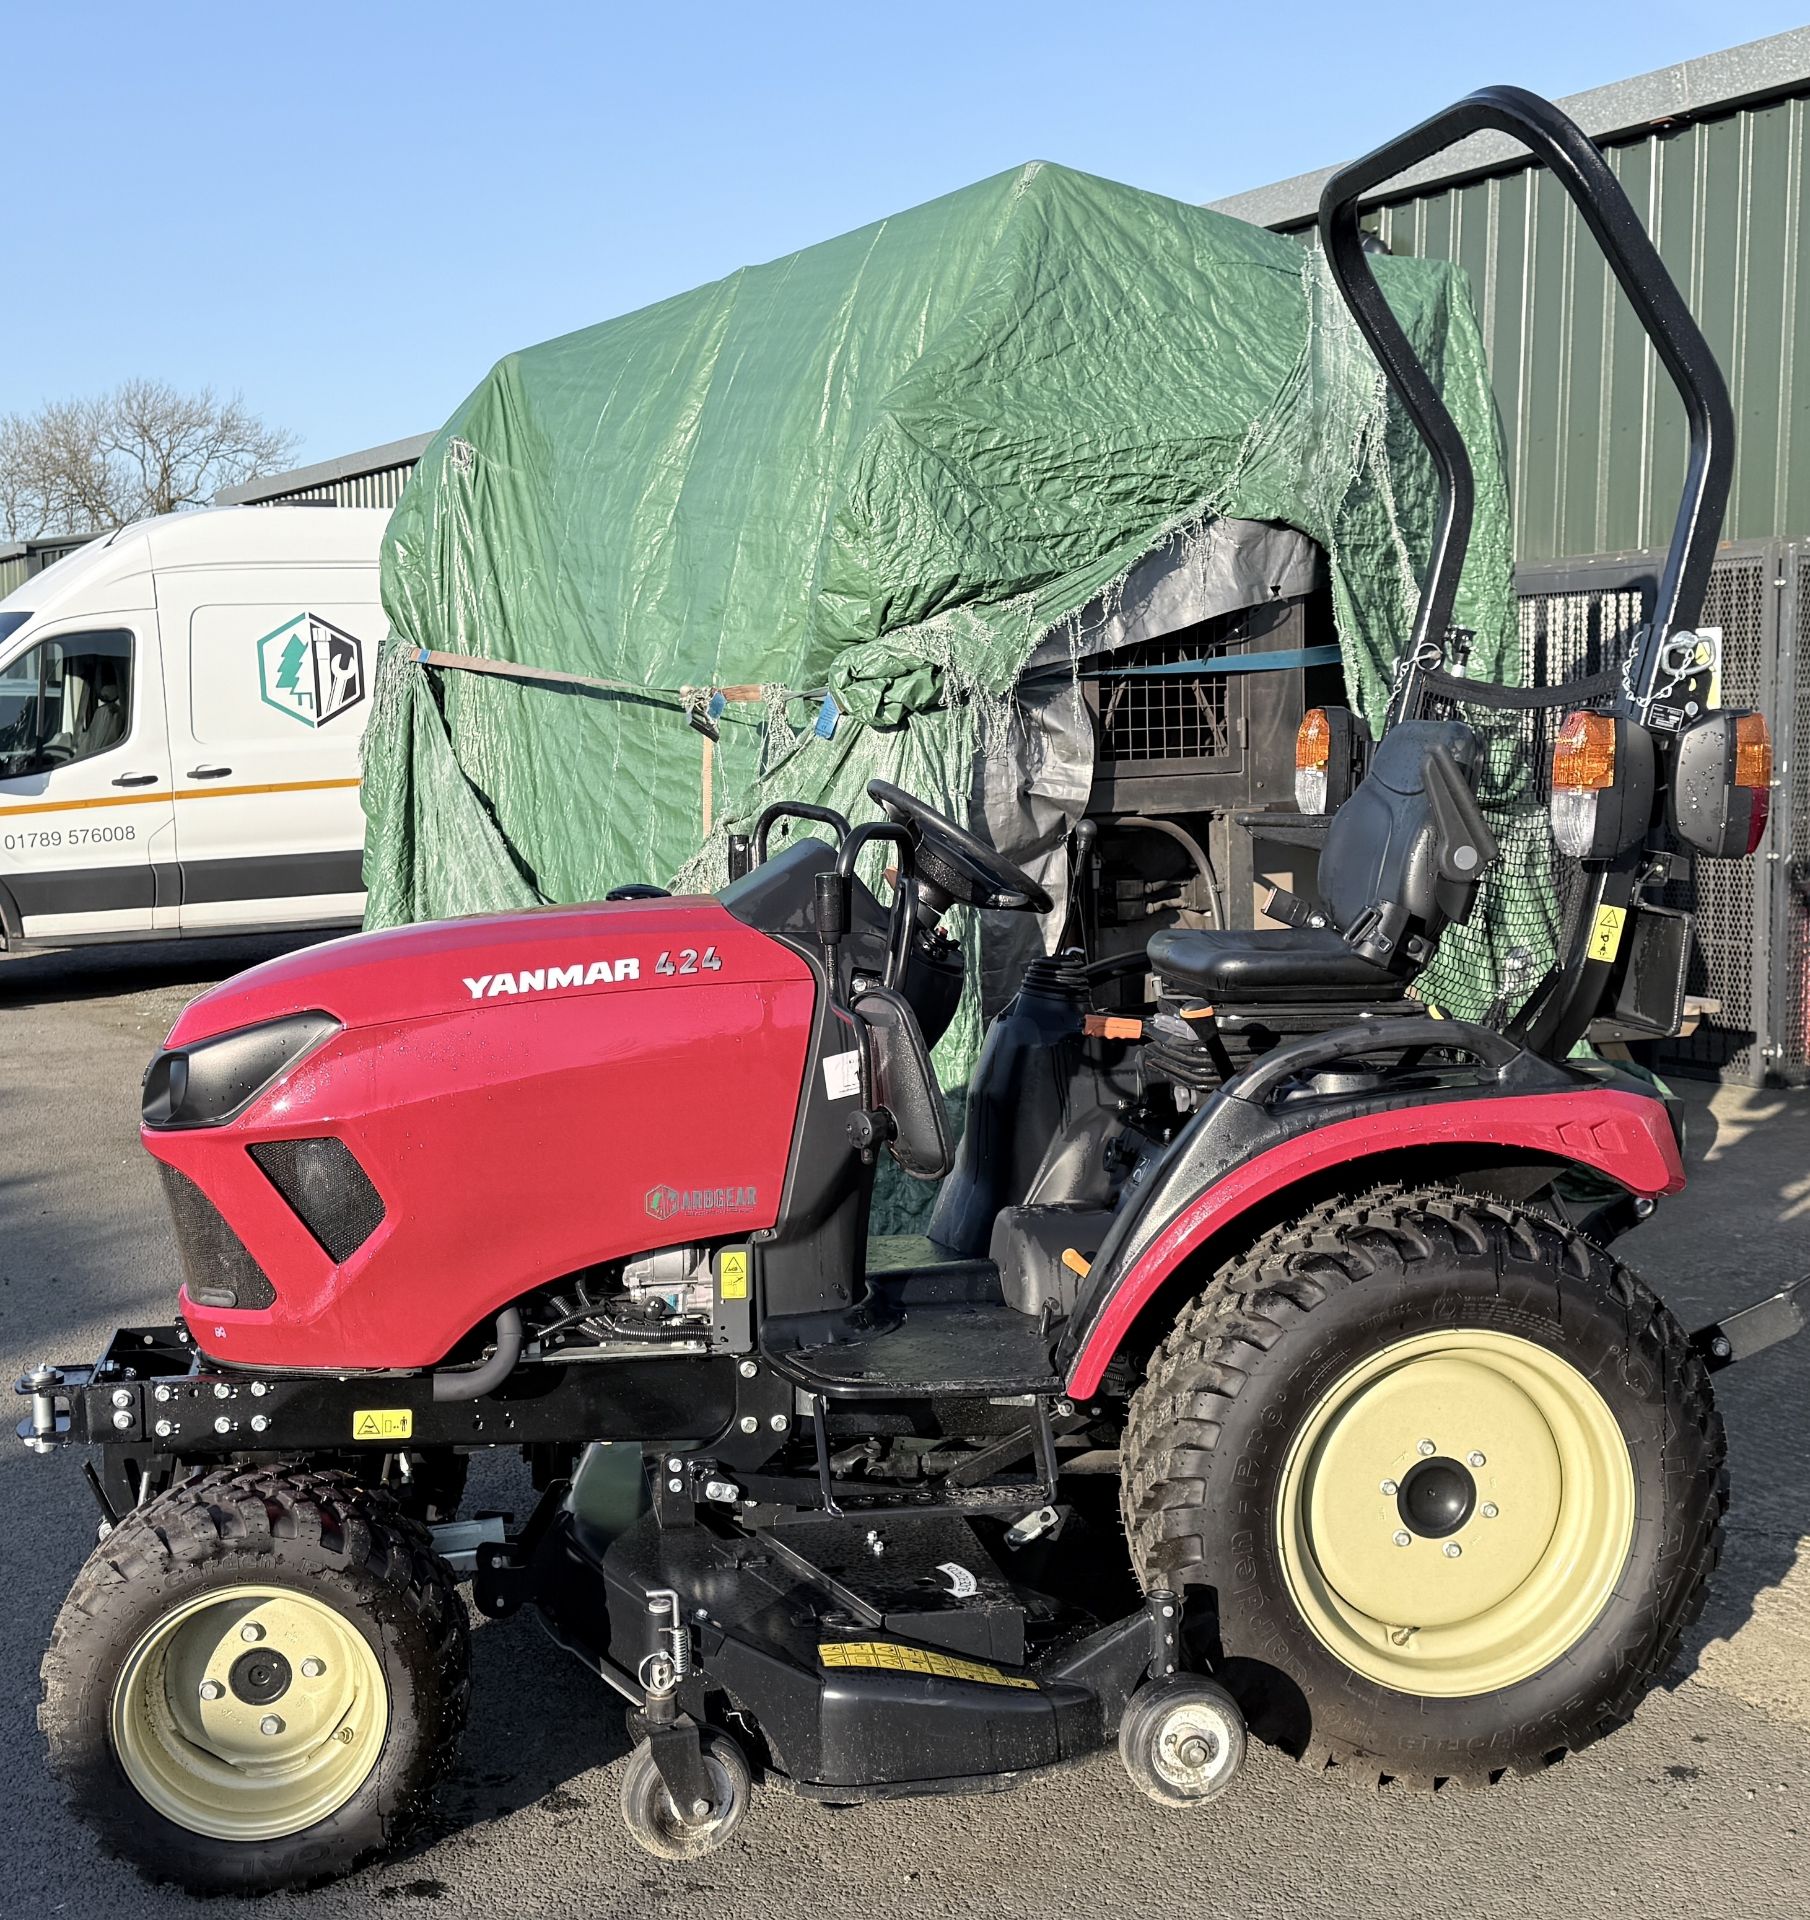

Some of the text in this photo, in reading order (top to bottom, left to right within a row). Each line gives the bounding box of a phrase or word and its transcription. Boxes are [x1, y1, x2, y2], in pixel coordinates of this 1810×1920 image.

[4, 825, 136, 850] 01789 576008
[463, 946, 722, 999] YANMAR 424
[1231, 1402, 1284, 1488] Pro
[163, 1552, 278, 1590] Garden
